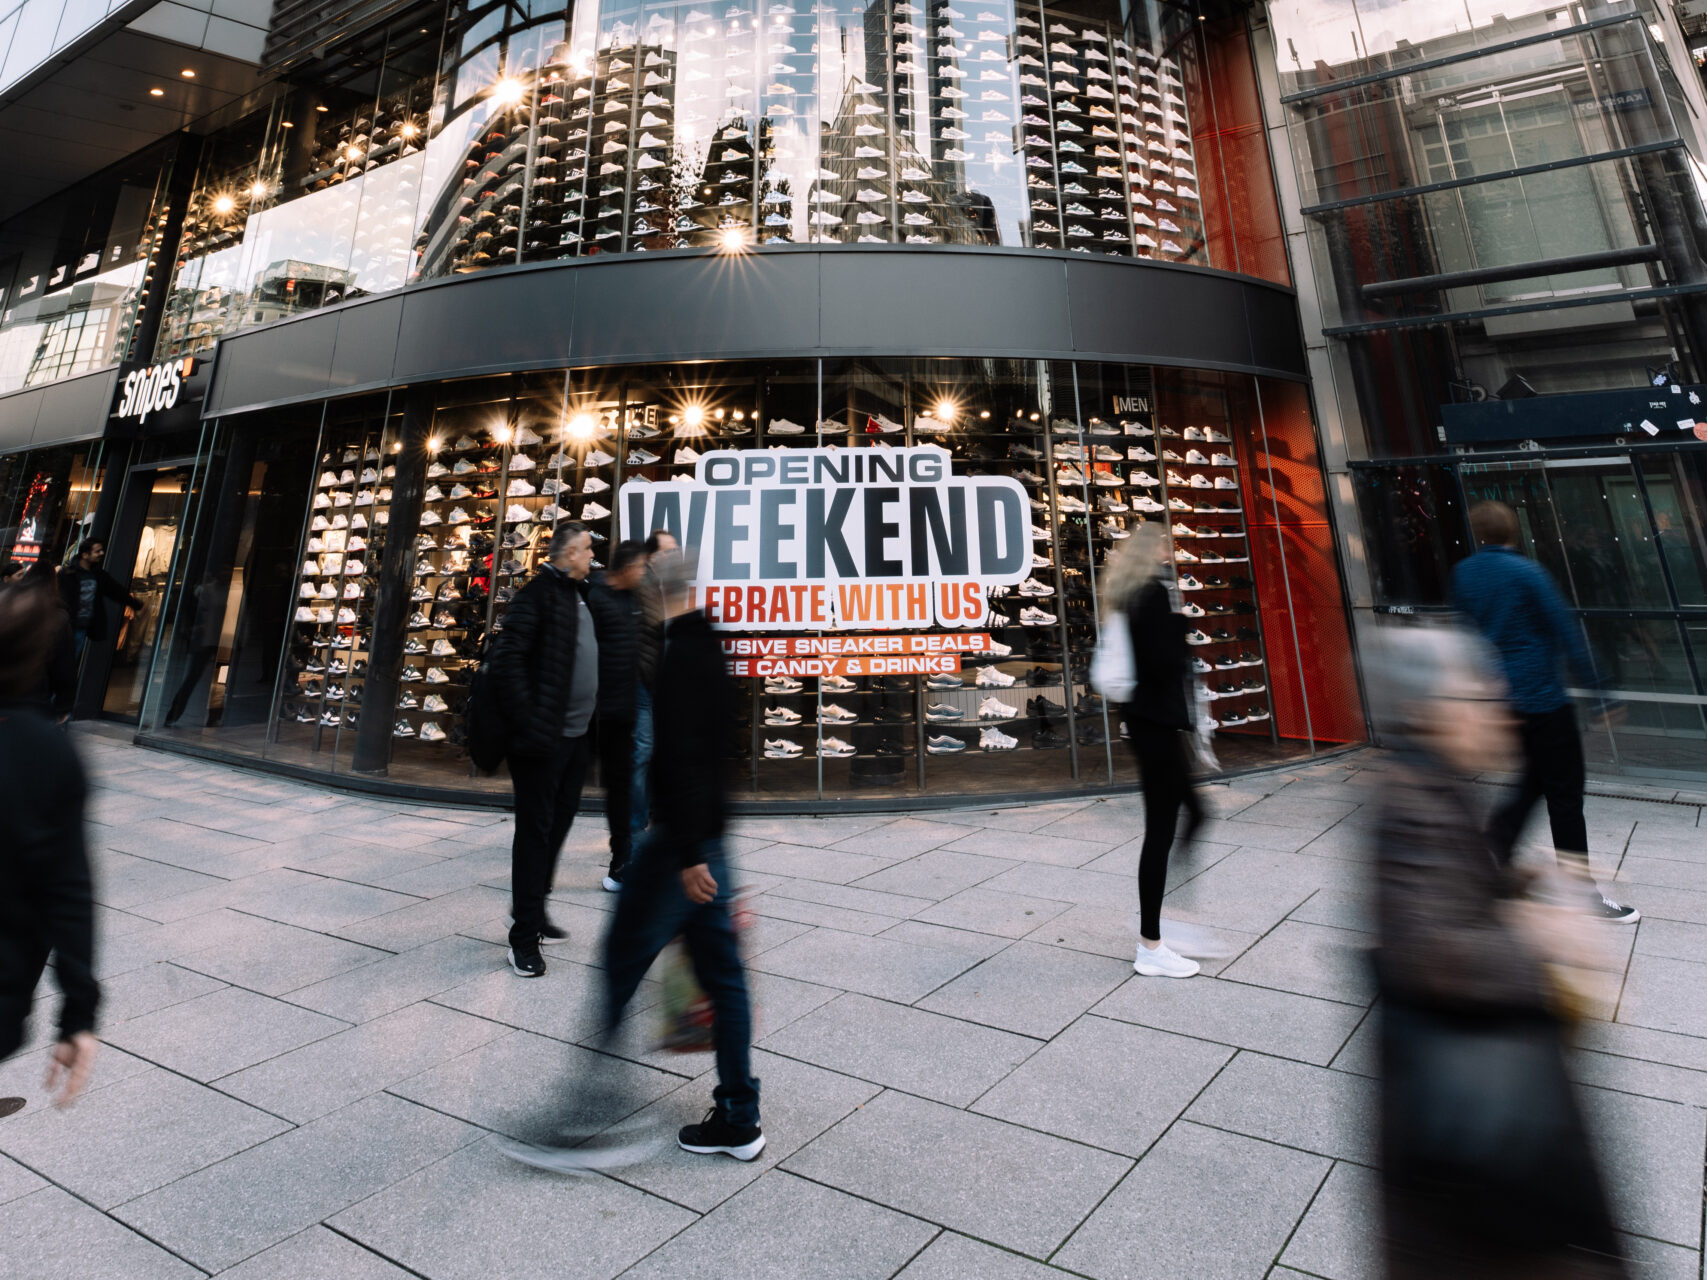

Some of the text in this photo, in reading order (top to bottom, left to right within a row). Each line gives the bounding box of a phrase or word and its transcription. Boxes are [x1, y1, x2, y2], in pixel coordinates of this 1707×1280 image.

[118, 359, 184, 425] snipes
[1119, 397, 1148, 412] MEN
[705, 453, 943, 486] OPENING
[628, 486, 1025, 580] WEEKEND
[688, 582, 982, 623] EBRATE WITH US
[720, 635, 984, 655] USIVE SNEAKER DEALS
[725, 657, 956, 675] EE CANDY & DRINKS
